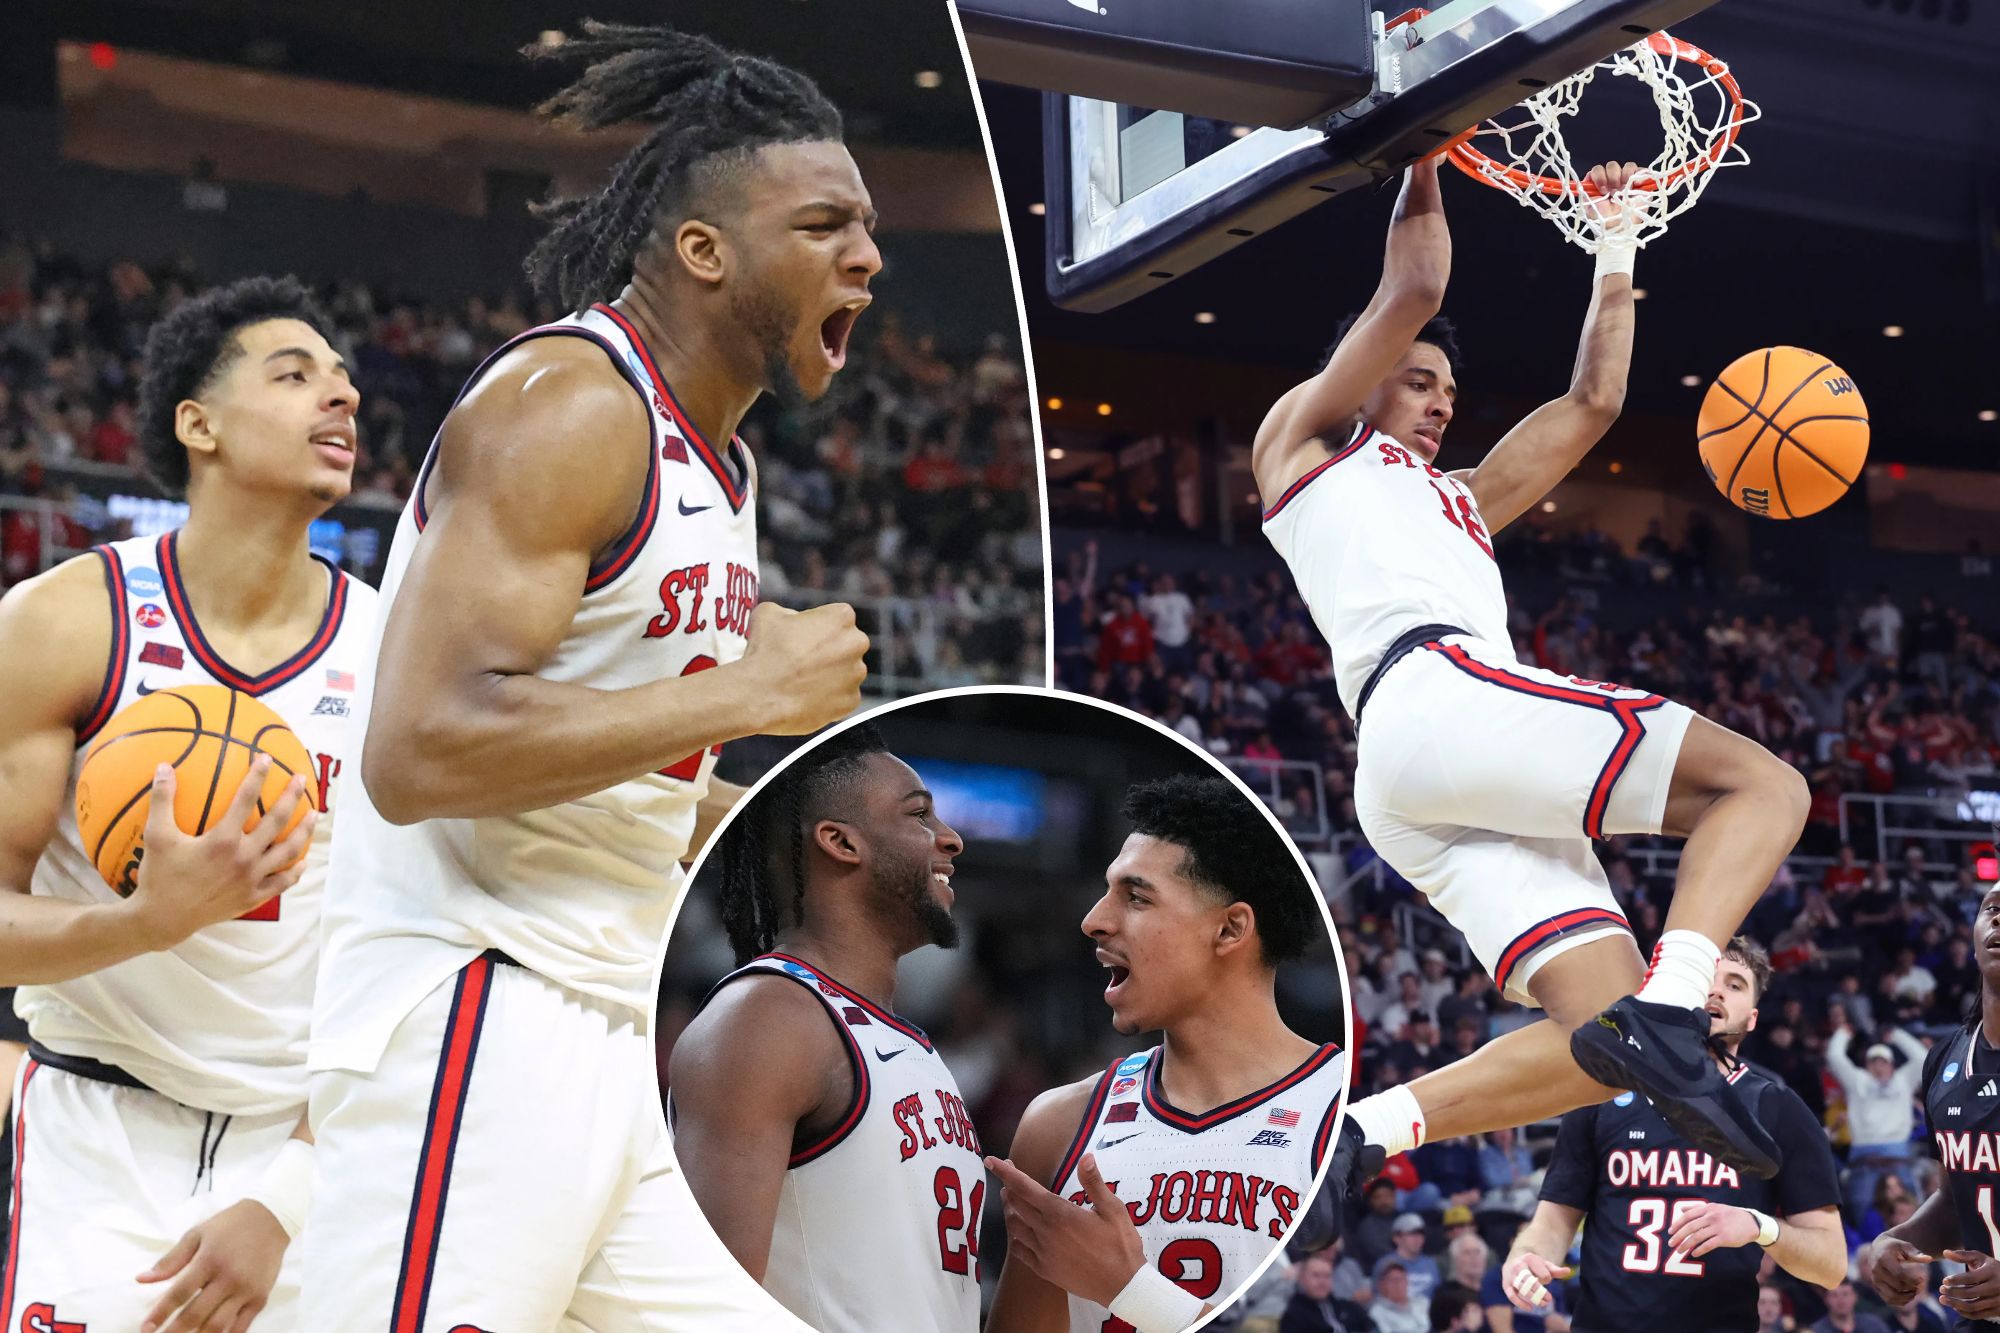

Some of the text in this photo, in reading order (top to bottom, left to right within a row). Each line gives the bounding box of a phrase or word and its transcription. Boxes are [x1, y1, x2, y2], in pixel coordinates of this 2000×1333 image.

[642, 562, 710, 639] ST.
[1948, 1106, 1962, 1116] HH
[892, 1091, 937, 1163] ST.
[1257, 1129, 1288, 1139] BIG
[1628, 1130, 1646, 1140] HH
[1249, 1137, 1293, 1147] EAST
[1606, 1148, 1741, 1189] OMAHA
[1125, 1168, 1300, 1241] JOHN'S
